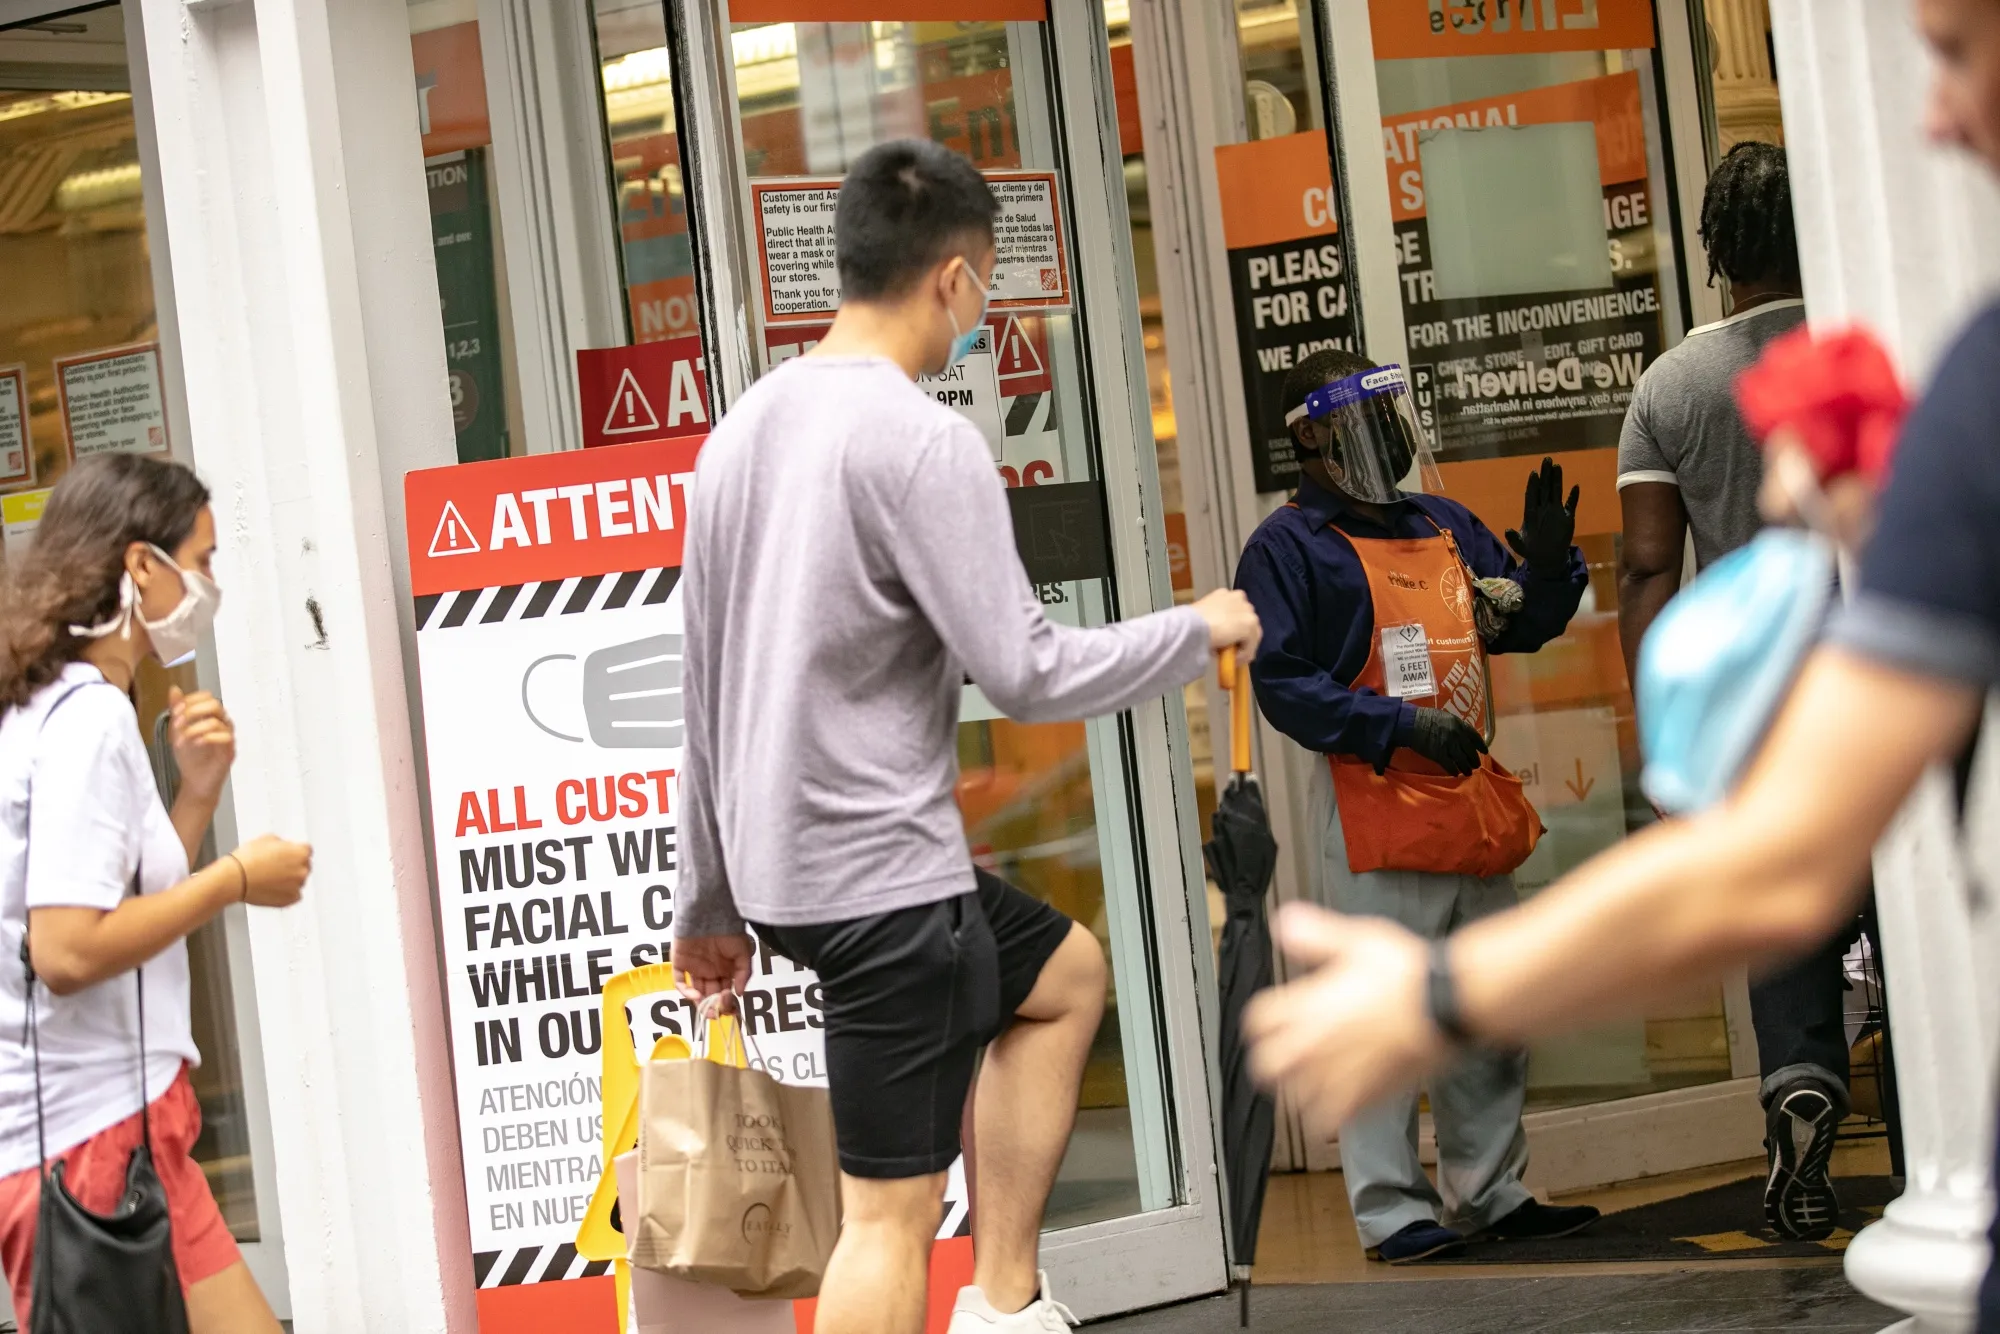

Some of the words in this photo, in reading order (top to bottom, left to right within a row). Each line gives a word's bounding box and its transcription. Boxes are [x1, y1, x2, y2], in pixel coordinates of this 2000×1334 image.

[427, 164, 468, 190] TION
[1002, 183, 1026, 193] cliente
[1028, 184, 1032, 193] y
[1034, 183, 1045, 191] del
[762, 192, 806, 203] Customer
[808, 191, 824, 201] and
[827, 190, 840, 200] As
[995, 194, 1014, 203] estra
[1016, 193, 1043, 204] primera
[764, 204, 790, 216] safety
[793, 204, 801, 213] is
[803, 204, 818, 213] our
[820, 202, 837, 212] first
[993, 215, 1003, 223] es
[1005, 214, 1014, 223] de
[1016, 213, 1036, 223] Salud
[766, 227, 795, 237] Public
[797, 225, 825, 236] Health
[1006, 226, 1019, 235] que
[1021, 224, 1041, 233] todas
[1043, 223, 1053, 232] las
[767, 238, 793, 249] direct
[795, 237, 814, 247] that
[815, 237, 826, 247] all
[827, 236, 836, 246] in
[1001, 236, 1015, 244] una
[1017, 234, 1048, 243] máscara
[769, 251, 790, 260] wear
[793, 251, 798, 259] a
[801, 248, 824, 258] mask
[826, 250, 835, 258] or
[1015, 244, 1047, 253] mientras
[1026, 254, 1053, 263] tiendas
[770, 261, 810, 272] covering
[812, 259, 835, 269] while
[1248, 245, 1343, 290] PLEAS
[771, 275, 787, 283] our
[789, 273, 820, 282] stores.
[773, 288, 801, 299] Thank
[803, 289, 821, 300] you
[822, 287, 835, 297] for
[774, 300, 831, 313] cooperation.
[1253, 290, 1311, 330] FOR
[1257, 346, 1293, 373] WE
[1408, 321, 1449, 349] FOR
[1452, 313, 1493, 342] THE
[1496, 288, 1660, 336] INCONVENIENCE.
[1543, 342, 1575, 360] EDIT,
[1577, 336, 1606, 356] GIFT
[1608, 331, 1644, 350] CARD
[1366, 376, 1389, 386] Face
[1400, 663, 1406, 672] 6
[1408, 660, 1427, 671] FEET
[1403, 671, 1428, 682] AWAY
[455, 785, 543, 838] ALL
[555, 768, 682, 826] CUST
[459, 835, 593, 894] MUST
[606, 825, 678, 877] WE
[464, 891, 629, 951] FACIAL
[642, 884, 677, 931] C
[466, 948, 614, 1008] WHILE
[474, 1017, 522, 1066] IN
[650, 981, 825, 1046] STRES
[479, 1071, 602, 1115] ATENCIÓN
[792, 1051, 827, 1080] CL
[483, 1119, 569, 1154] DEBEN
[577, 1114, 603, 1144] US
[734, 1158, 757, 1173] TO
[486, 1154, 602, 1193] MIENTRA
[490, 1201, 524, 1231] EN
